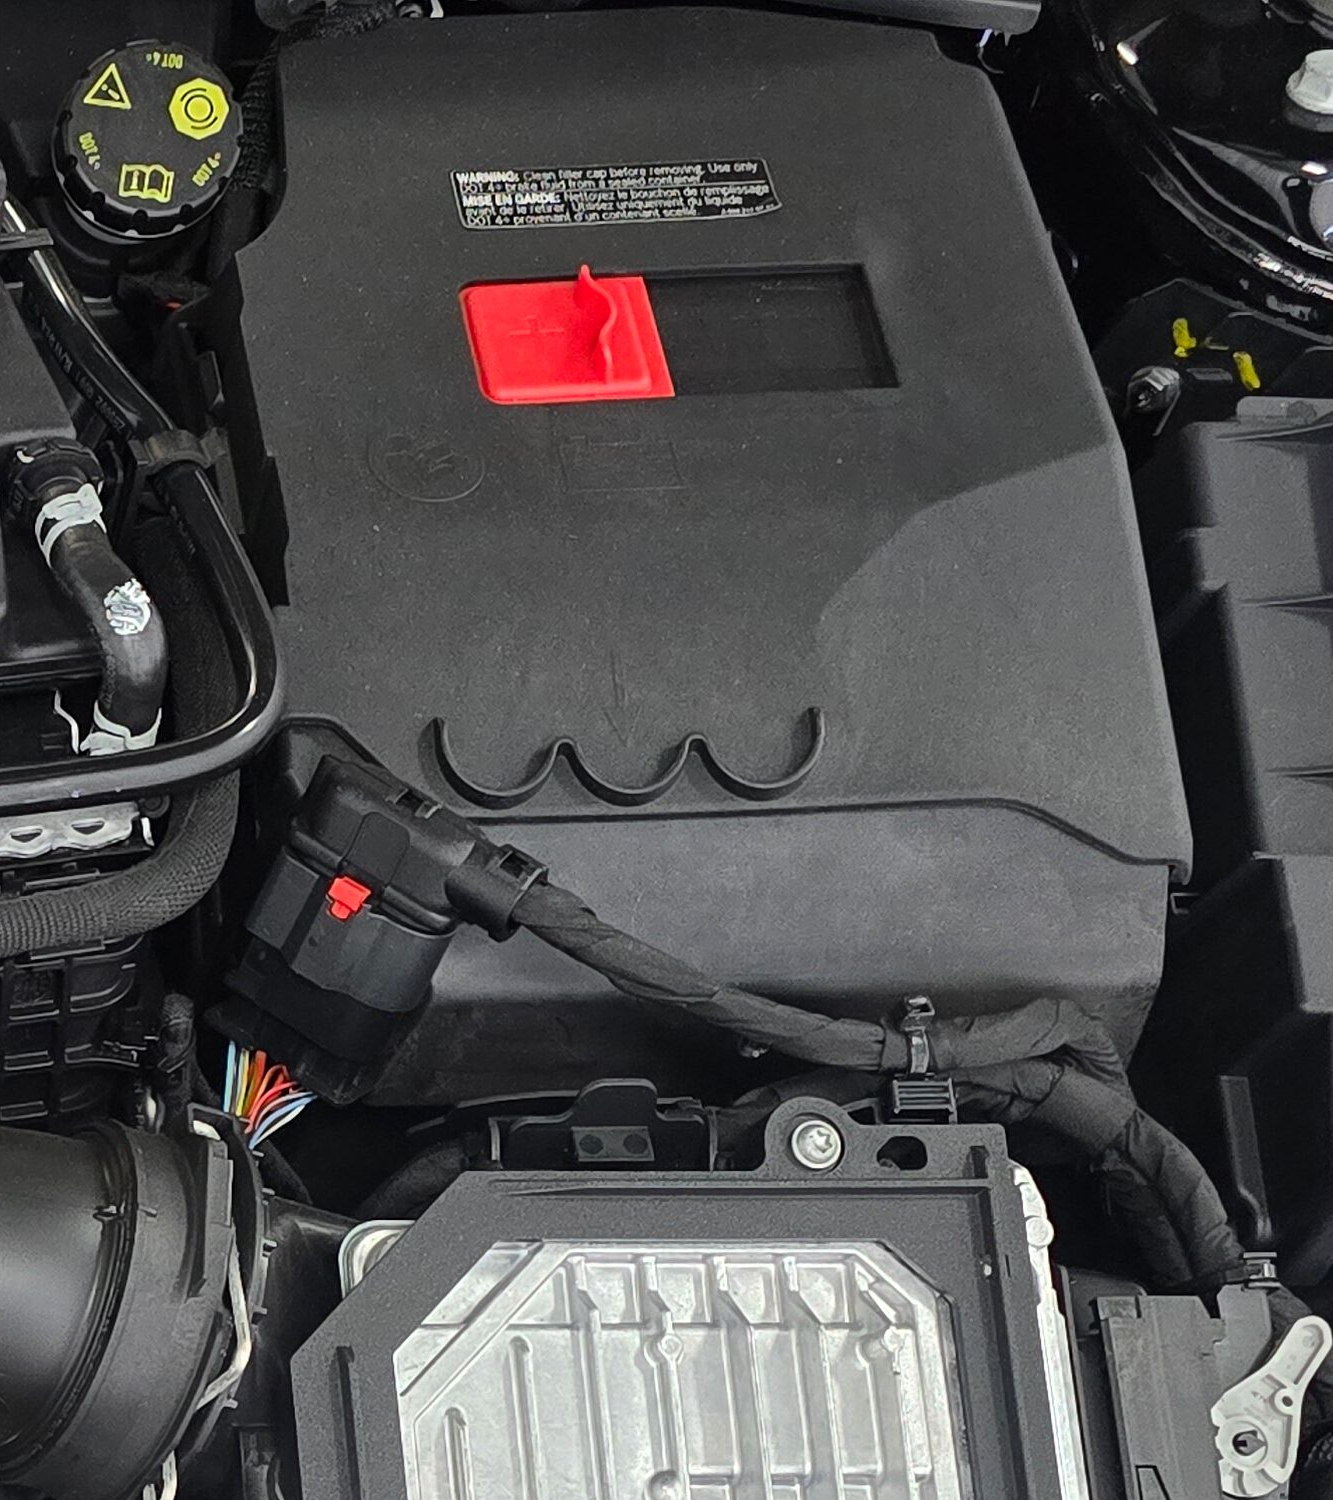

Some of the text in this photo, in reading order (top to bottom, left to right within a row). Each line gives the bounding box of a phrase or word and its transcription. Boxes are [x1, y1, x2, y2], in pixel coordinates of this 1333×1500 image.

[162, 53, 183, 69] DOT
[78, 131, 97, 157] DOT
[192, 166, 213, 187] DOT
[456, 170, 520, 183] WARNING:
[524, 170, 556, 182] Clean
[559, 169, 583, 180] filler
[586, 170, 607, 181] cap
[610, 167, 646, 178] before
[708, 163, 731, 174] Use
[734, 161, 758, 174] only
[505, 181, 538, 192] brake
[569, 178, 596, 190] from
[463, 194, 493, 207] MISE
[495, 193, 513, 206] EN
[515, 192, 561, 205] GARDE:
[630, 187, 680, 199] bouchon
[683, 186, 698, 196] de
[499, 205, 513, 215] de
[617, 198, 683, 211] uniquement
[513, 213, 571, 226] provenant
[603, 208, 660, 220] contenant
